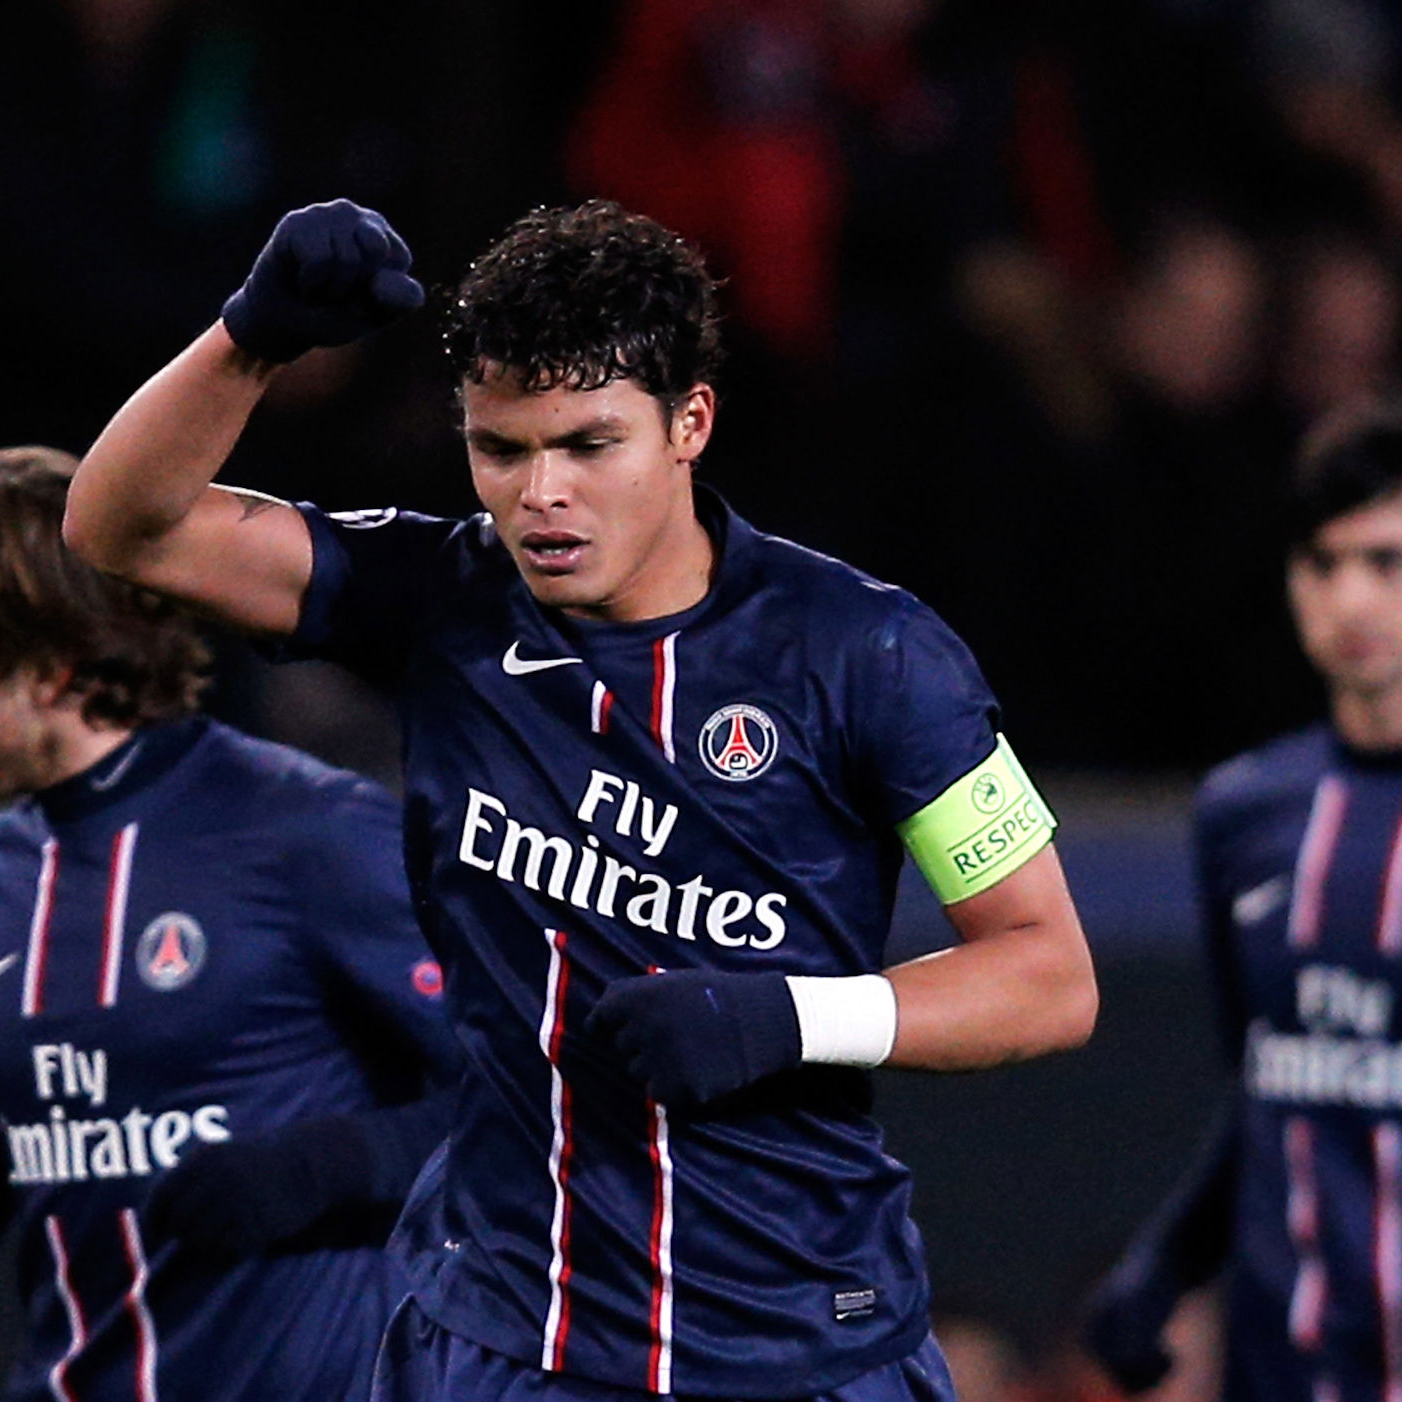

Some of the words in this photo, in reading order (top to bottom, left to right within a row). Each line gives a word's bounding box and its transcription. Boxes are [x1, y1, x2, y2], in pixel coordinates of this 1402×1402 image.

[578, 769, 678, 857] Fly
[953, 799, 1038, 875] RESPEC
[459, 787, 787, 951] Emirates
[32, 1042, 107, 1106] Fly
[0, 1104, 232, 1184] mirates
